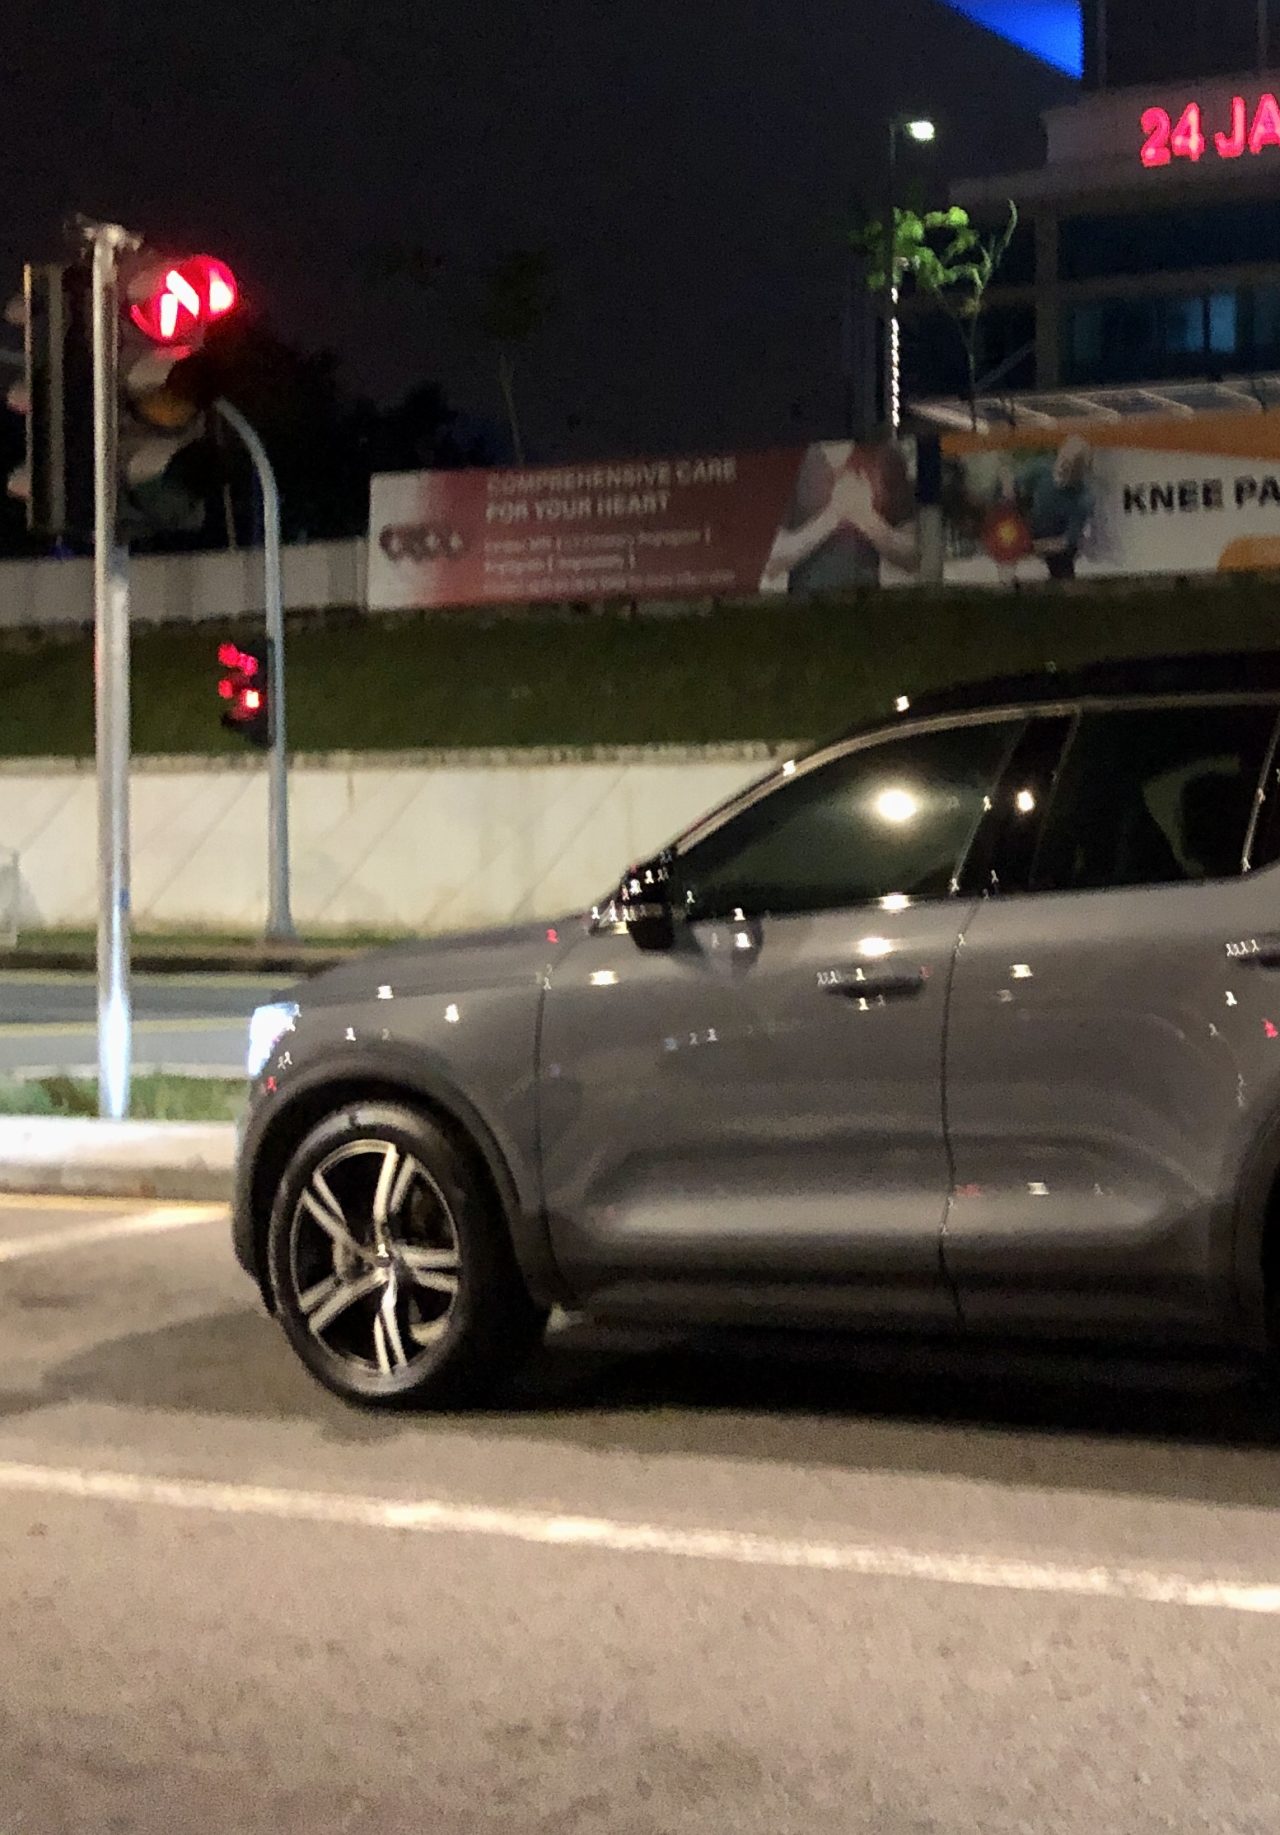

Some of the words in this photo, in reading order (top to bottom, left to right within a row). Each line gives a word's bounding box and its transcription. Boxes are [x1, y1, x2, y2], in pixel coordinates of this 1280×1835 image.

[1141, 102, 1205, 168] 24
[536, 496, 592, 521] YOUR
[1122, 478, 1224, 515] KNEE
